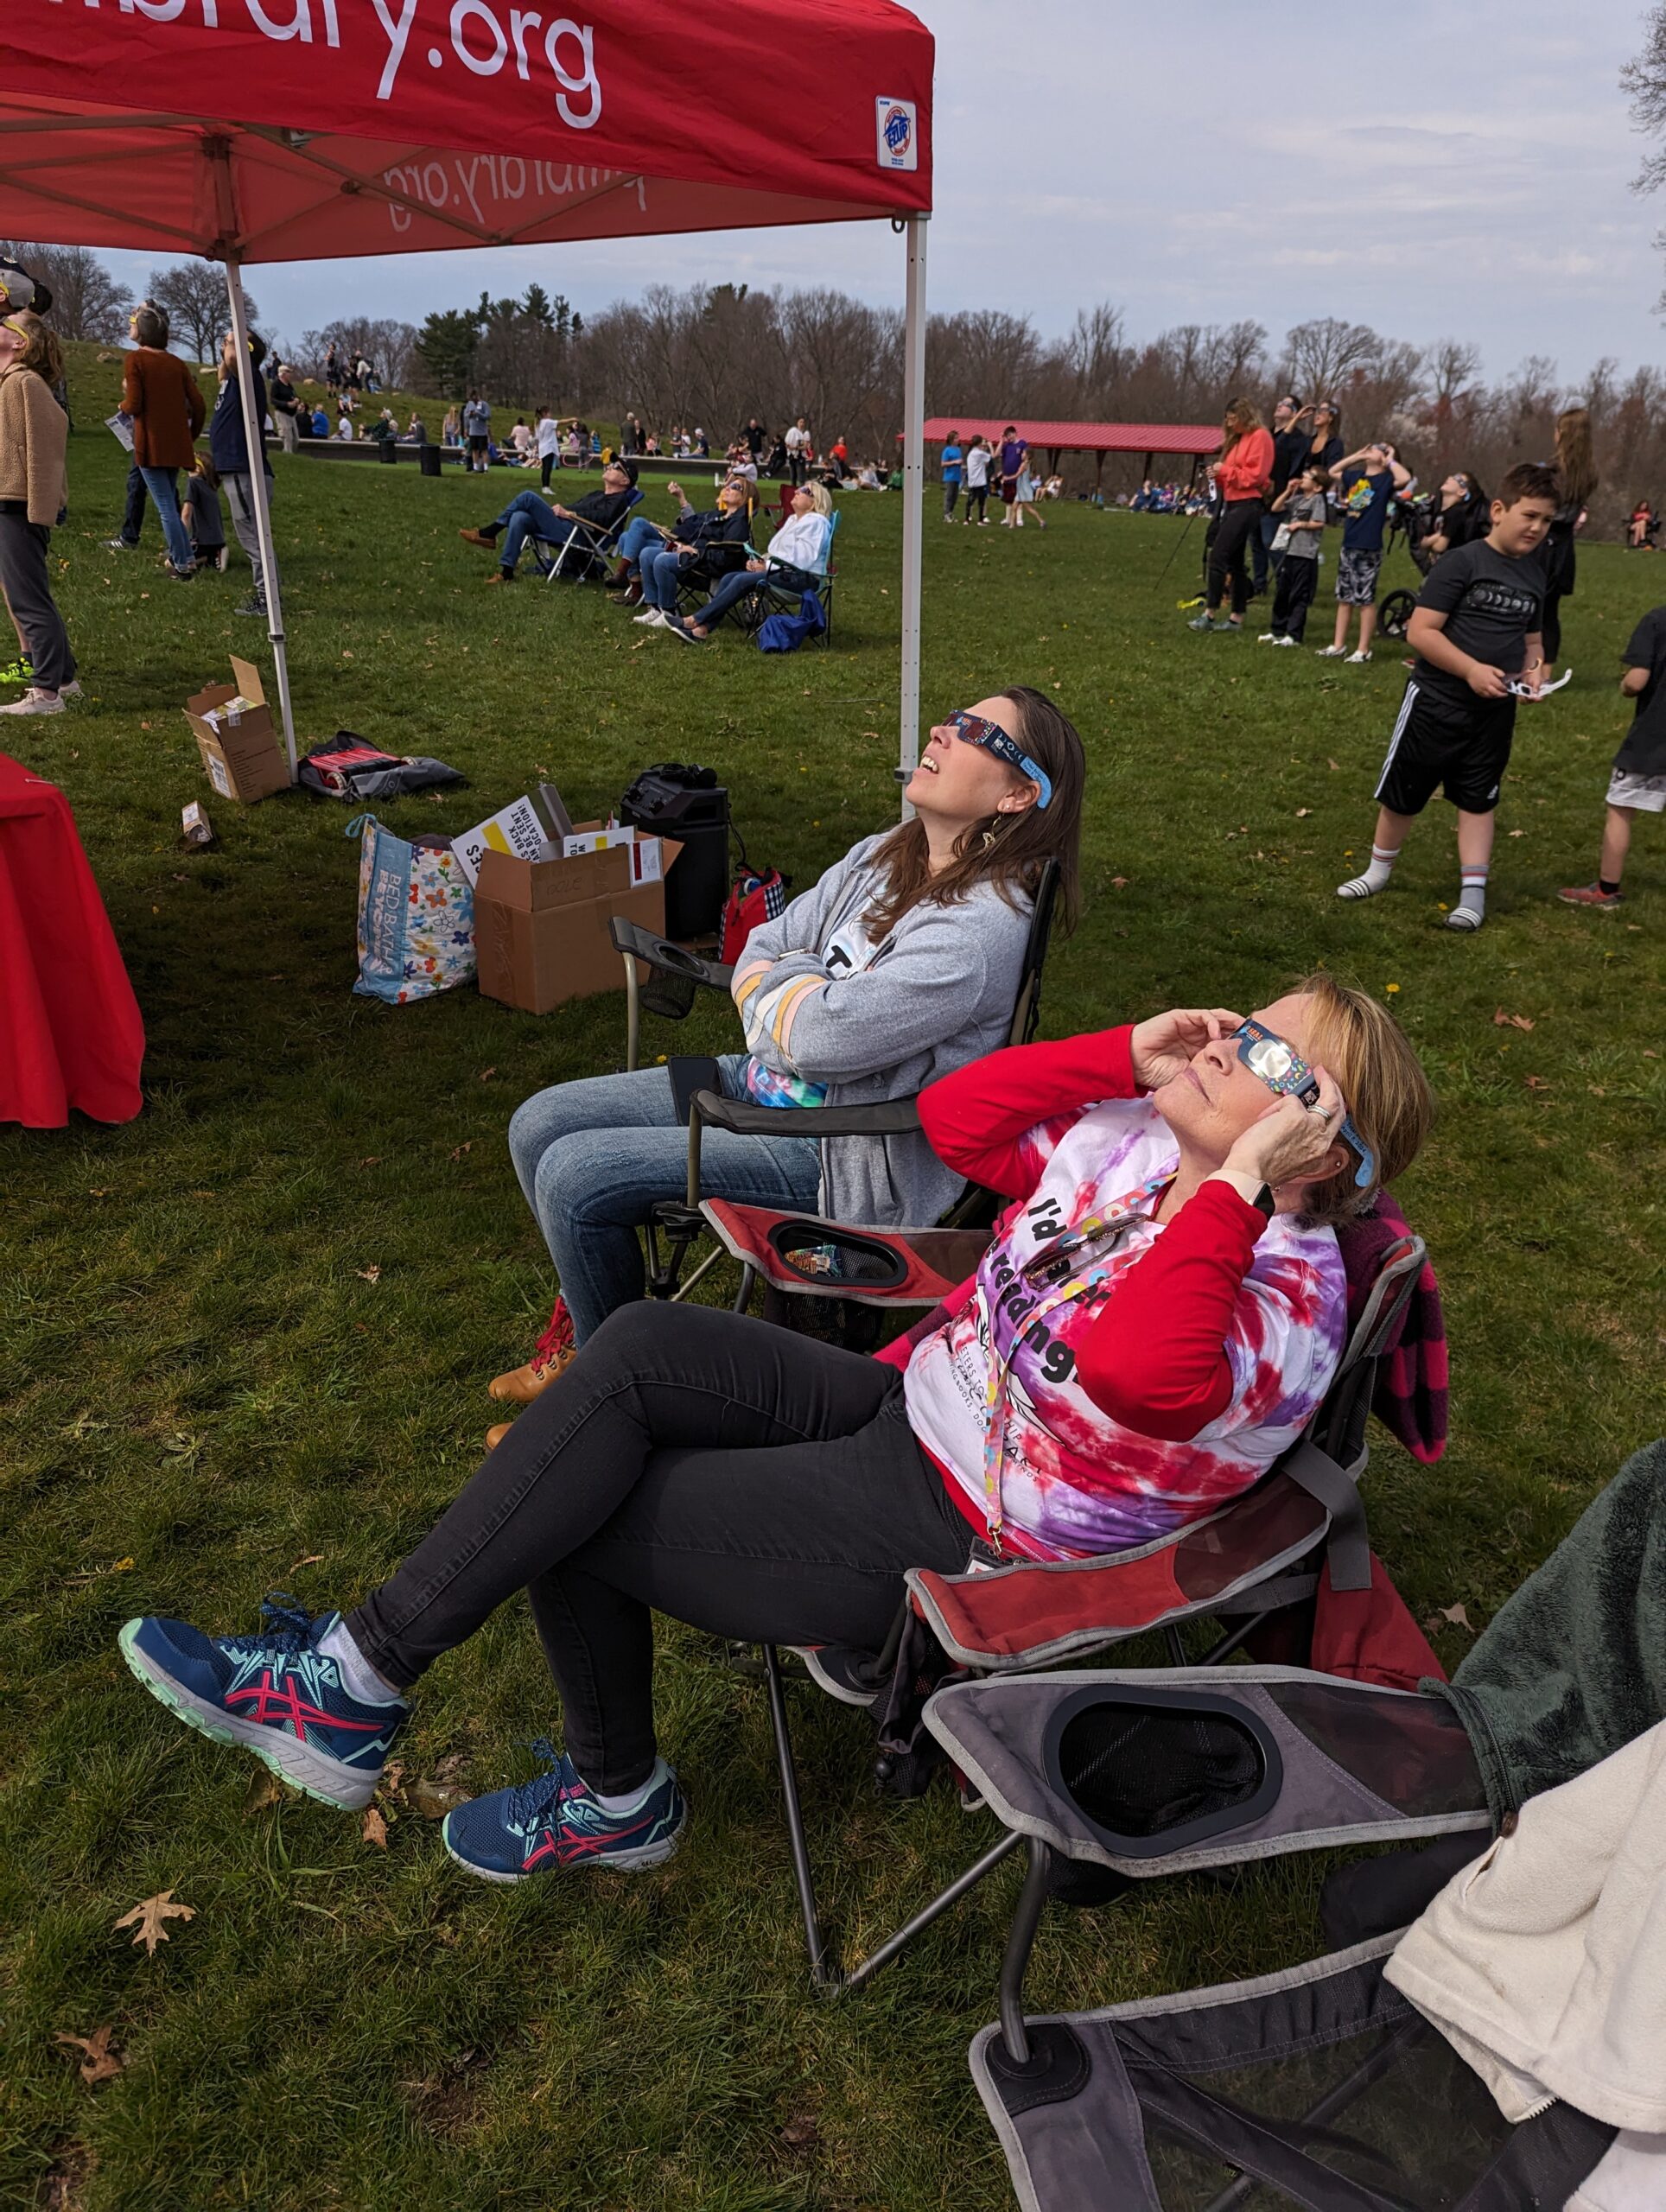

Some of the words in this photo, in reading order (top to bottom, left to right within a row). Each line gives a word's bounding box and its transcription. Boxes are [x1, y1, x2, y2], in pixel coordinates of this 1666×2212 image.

[508, 826, 525, 850] BACK
[511, 811, 527, 836] SENT
[516, 804, 543, 851] OCATION!
[523, 835, 534, 848] BE
[387, 873, 402, 911] BED
[381, 912, 398, 965] BATH
[1027, 1198, 1068, 1242] I'd
